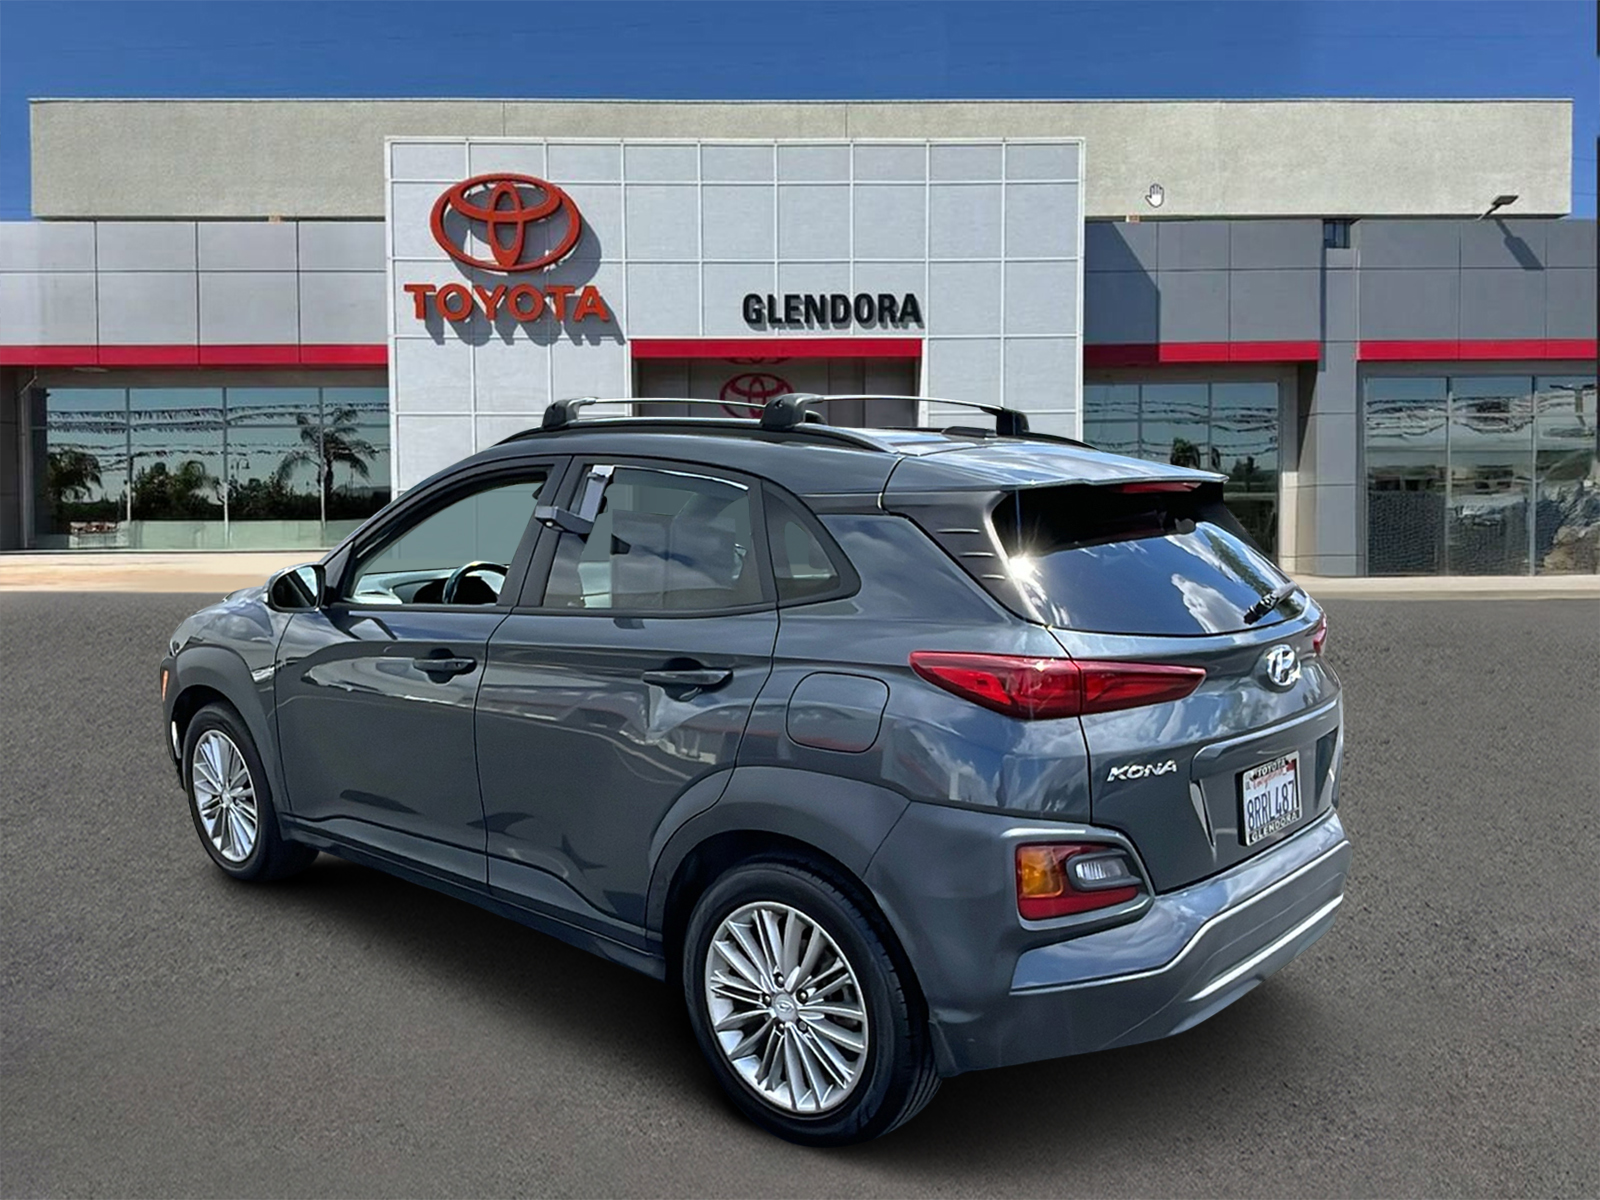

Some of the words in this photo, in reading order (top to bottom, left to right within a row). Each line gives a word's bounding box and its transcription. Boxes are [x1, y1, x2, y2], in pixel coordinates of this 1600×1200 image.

[404, 283, 611, 322] TOYOTA
[742, 293, 923, 327] GLENDORA
[1107, 760, 1178, 782] KONA
[1258, 758, 1287, 777] TOYOTA
[1247, 780, 1295, 832] 8RRL487
[1251, 811, 1298, 842] GLENDORA
